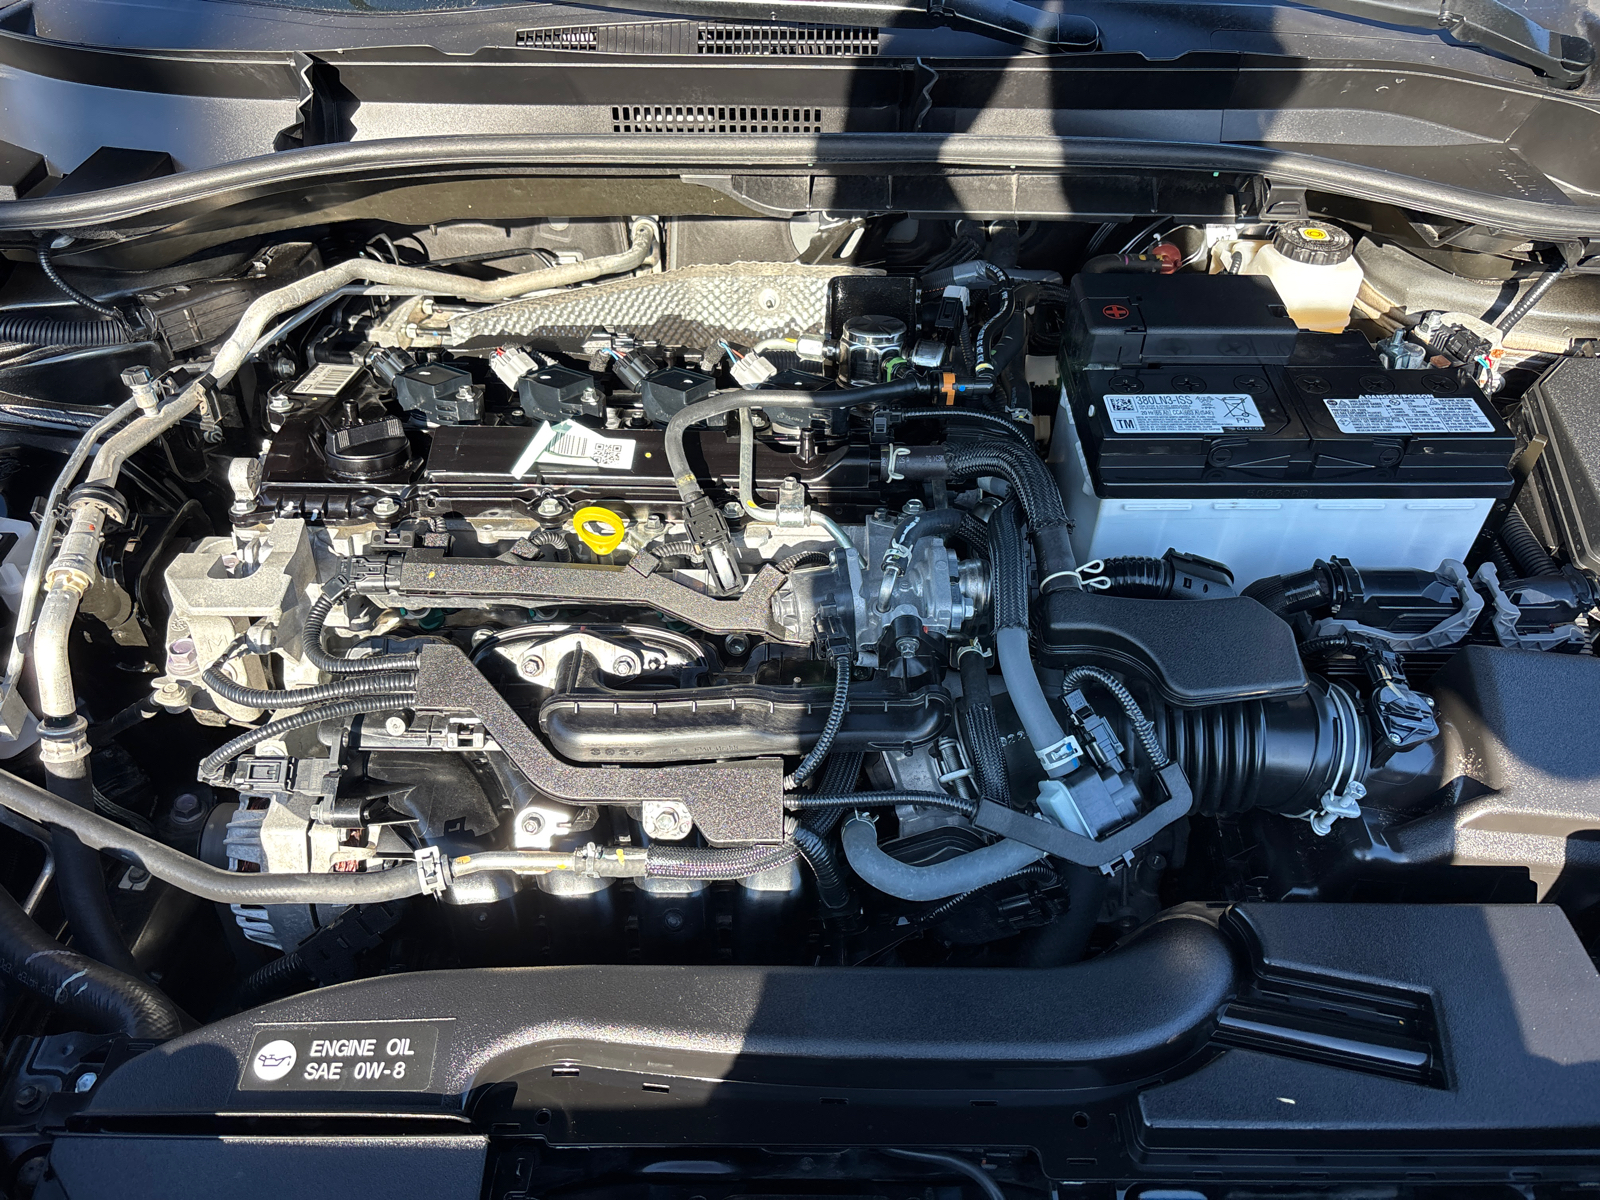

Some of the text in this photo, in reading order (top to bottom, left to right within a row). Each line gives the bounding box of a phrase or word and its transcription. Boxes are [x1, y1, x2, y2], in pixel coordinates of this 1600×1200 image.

[1136, 395, 1193, 405] 380LN3-ISS
[1117, 419, 1135, 429] TM
[309, 1038, 415, 1057] ENGINE OIL
[303, 1061, 406, 1080] SAE 0W-8
